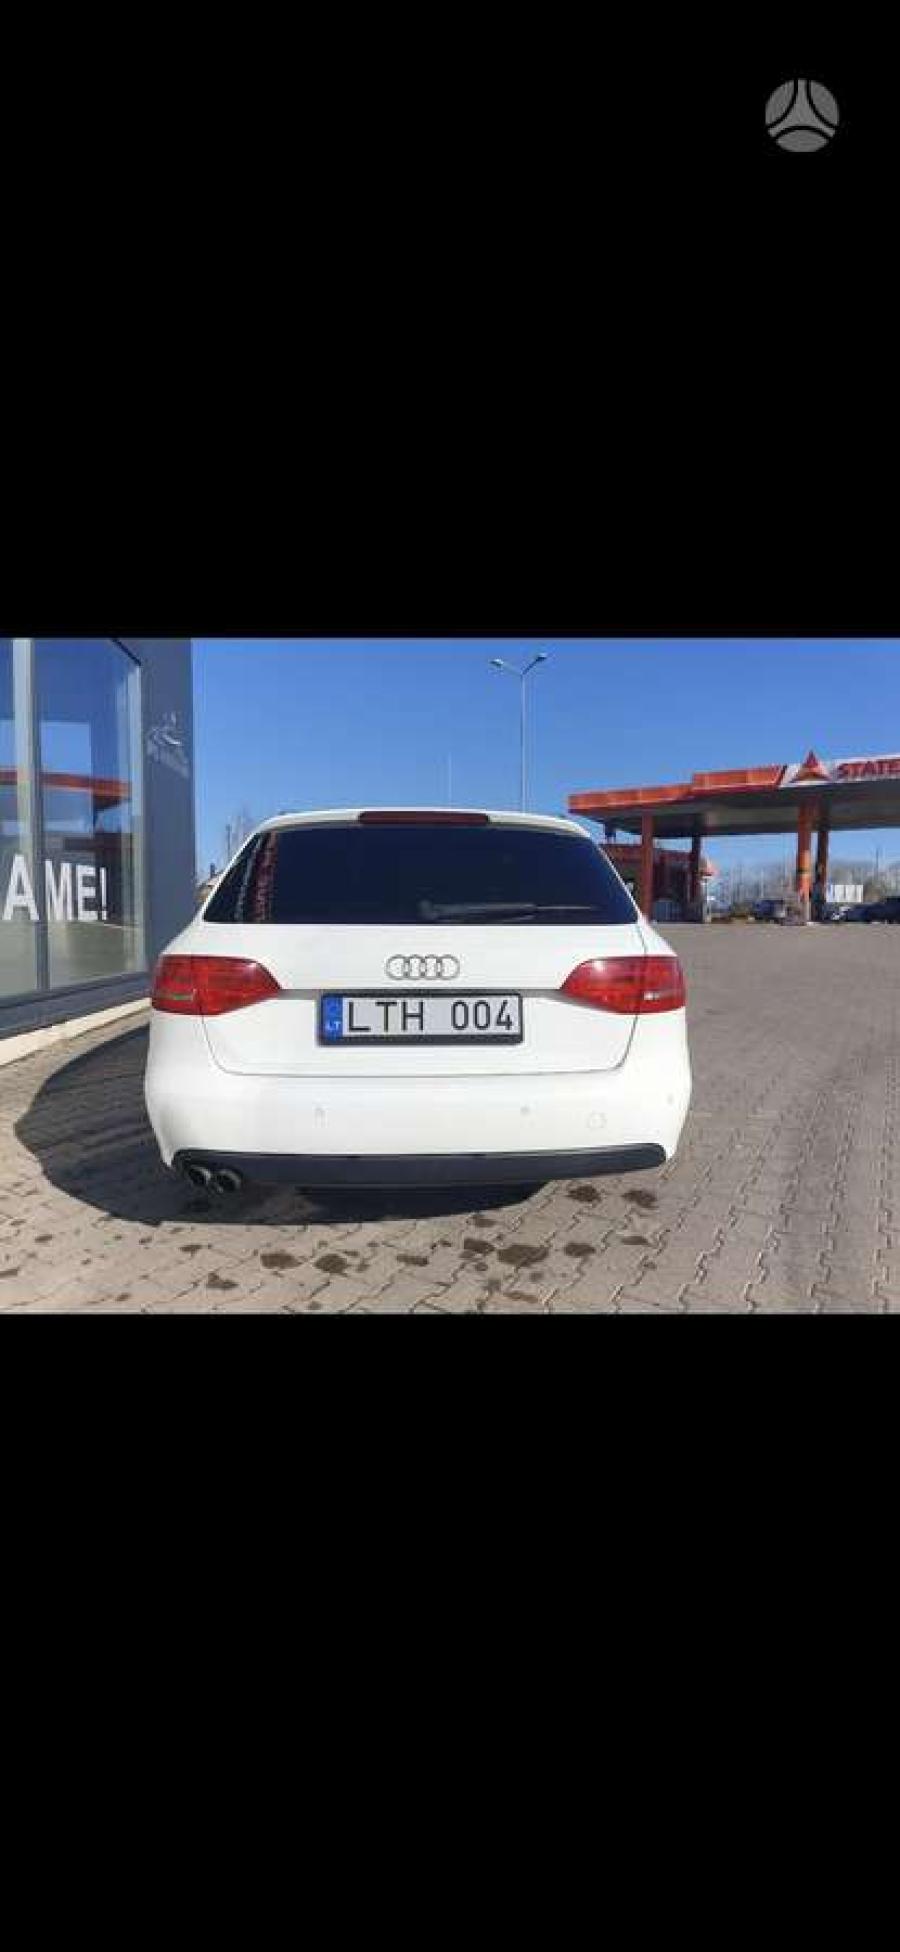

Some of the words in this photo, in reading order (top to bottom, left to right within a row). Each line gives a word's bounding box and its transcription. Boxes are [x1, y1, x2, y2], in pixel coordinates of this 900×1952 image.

[326, 1020, 341, 1031] LT
[349, 1001, 424, 1032] LTH
[452, 1000, 512, 1031] 004
